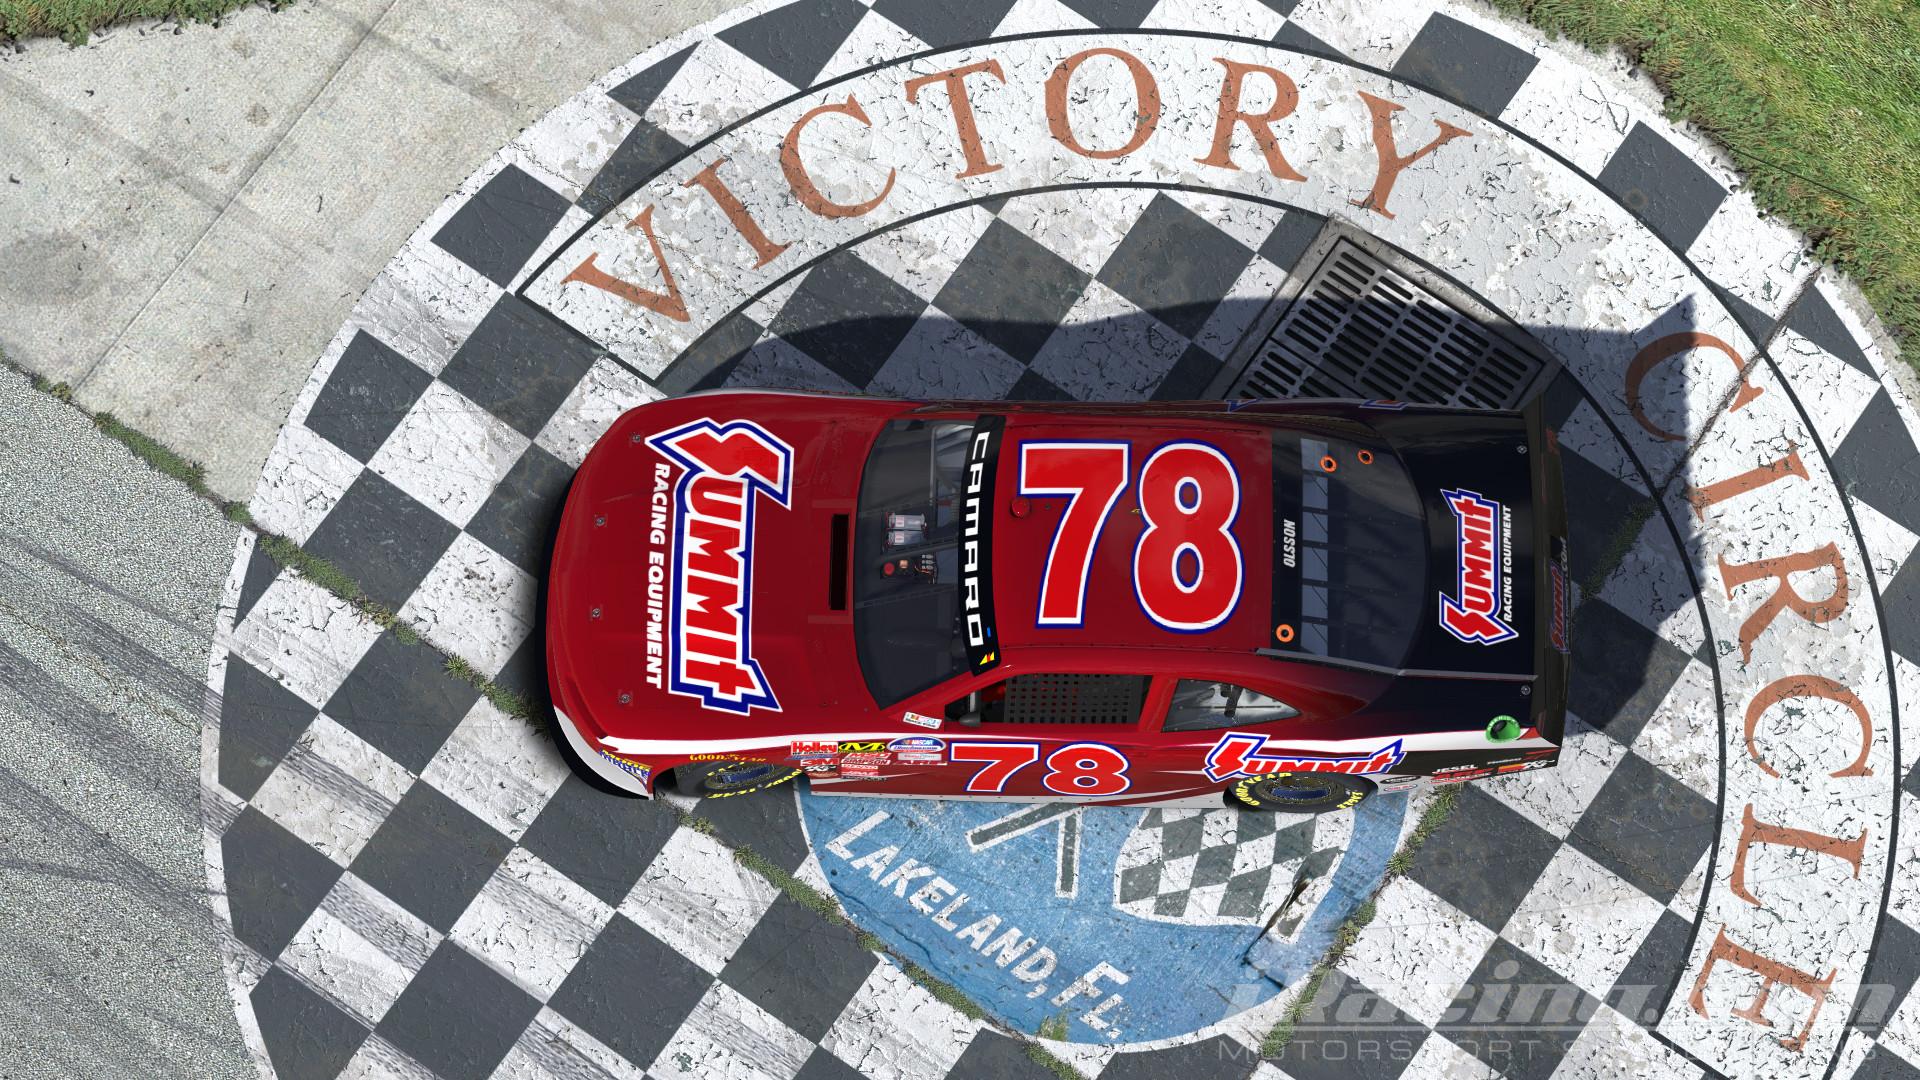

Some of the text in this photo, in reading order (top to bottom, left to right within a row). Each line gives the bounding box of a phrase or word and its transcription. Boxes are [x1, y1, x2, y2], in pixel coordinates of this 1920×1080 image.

[561, 47, 1474, 322] VICTORY
[646, 462, 671, 689] RACING EQUIPMENT
[964, 431, 990, 647] CAMARO
[1017, 438, 1246, 635] 78
[1283, 518, 1296, 568] OLSSON
[1503, 505, 1513, 622] RACING EQUIPMENT
[792, 741, 838, 752] Holley
[949, 741, 1133, 796] 78
[1624, 330, 1873, 1054] CIRCLE
[825, 810, 1058, 999] LAKELAND,
